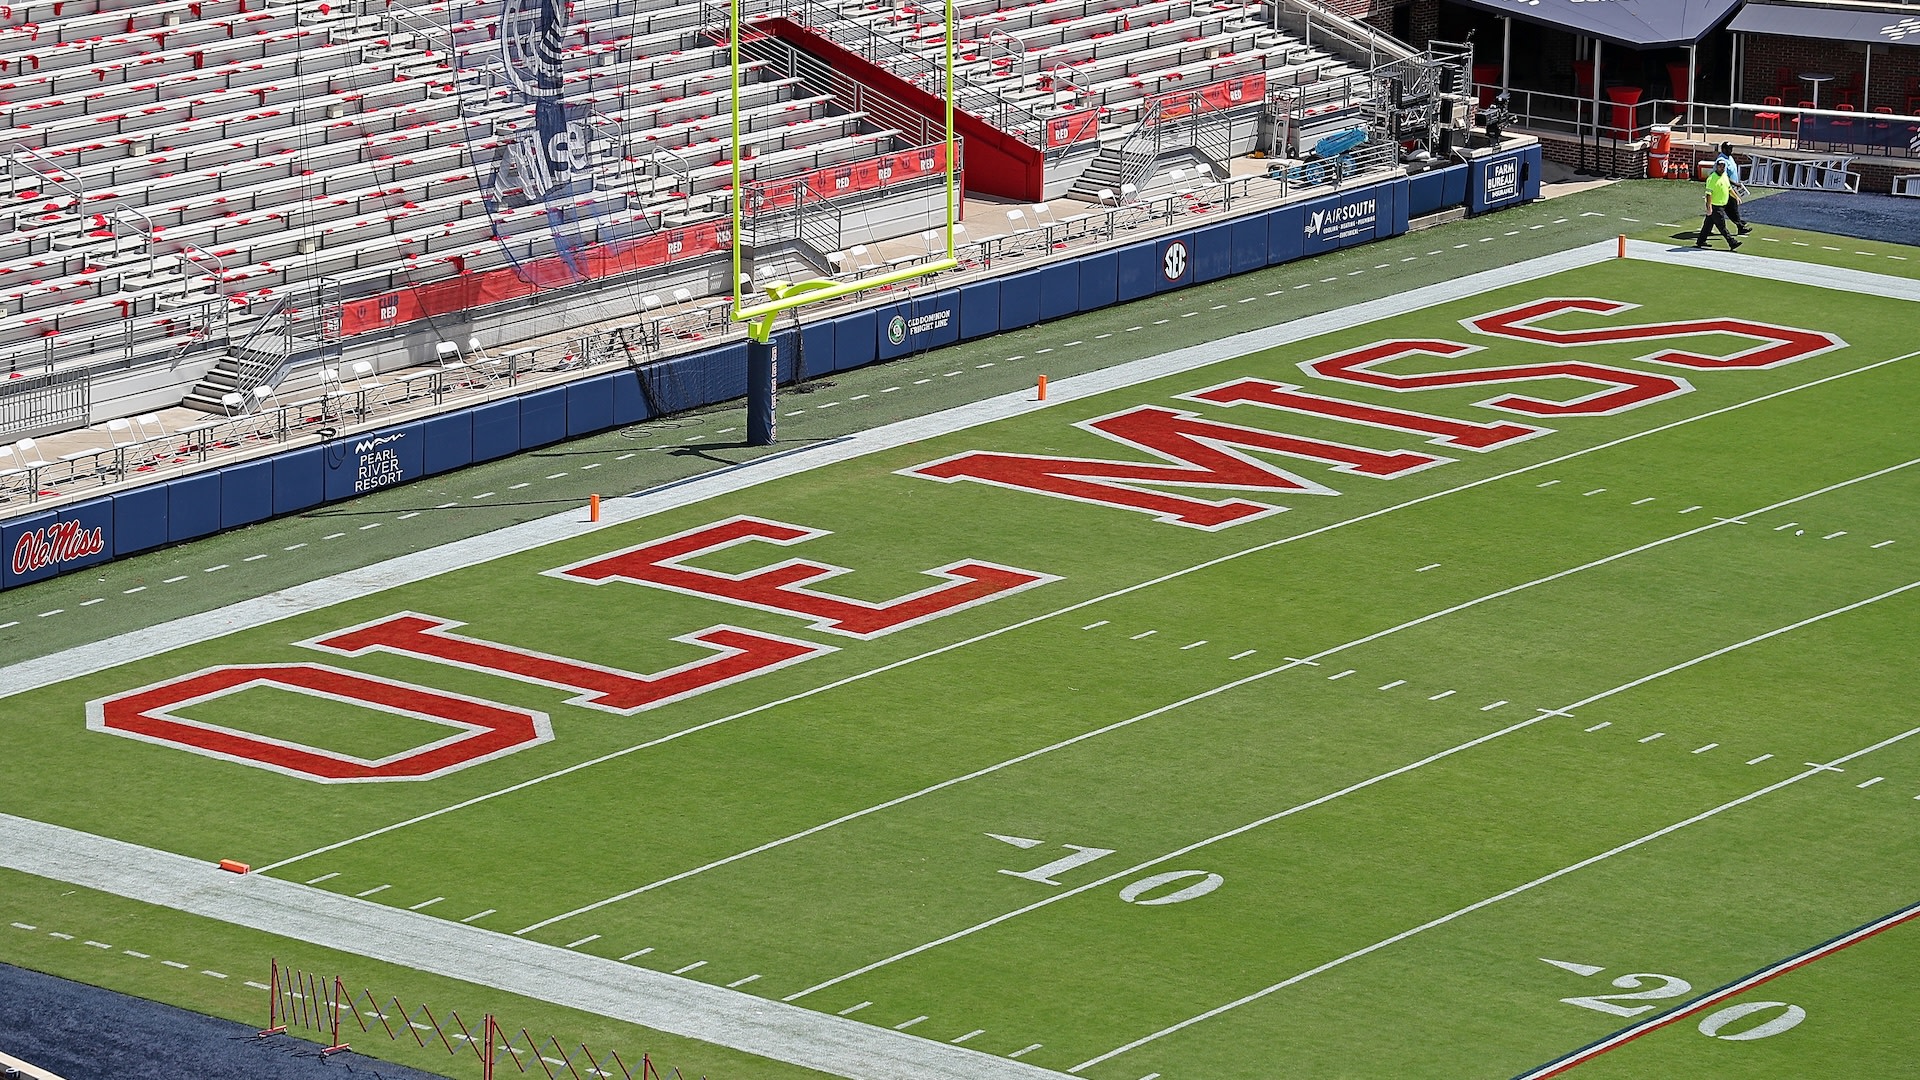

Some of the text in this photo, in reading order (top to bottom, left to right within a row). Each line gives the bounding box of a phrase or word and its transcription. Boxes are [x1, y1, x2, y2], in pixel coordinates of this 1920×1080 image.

[1230, 89, 1243, 101] RED
[1055, 129, 1069, 141] RED
[920, 158, 935, 171] RED
[1495, 163, 1515, 177] FARM
[878, 167, 892, 180] RED
[835, 176, 850, 190] RED
[1487, 173, 1515, 190] BUREAU
[1324, 199, 1376, 225] AIRSOUTH
[668, 241, 683, 255] RED
[1164, 242, 1187, 279] SEC
[380, 306, 398, 320] RED
[919, 310, 951, 324] DOMINION
[934, 318, 949, 329] LINE
[360, 448, 397, 466] PEARL
[359, 458, 399, 480] RIVER
[355, 470, 403, 492] RESORT
[12, 519, 104, 574] Ole Miss
[85, 297, 1850, 784] OLE MISS
